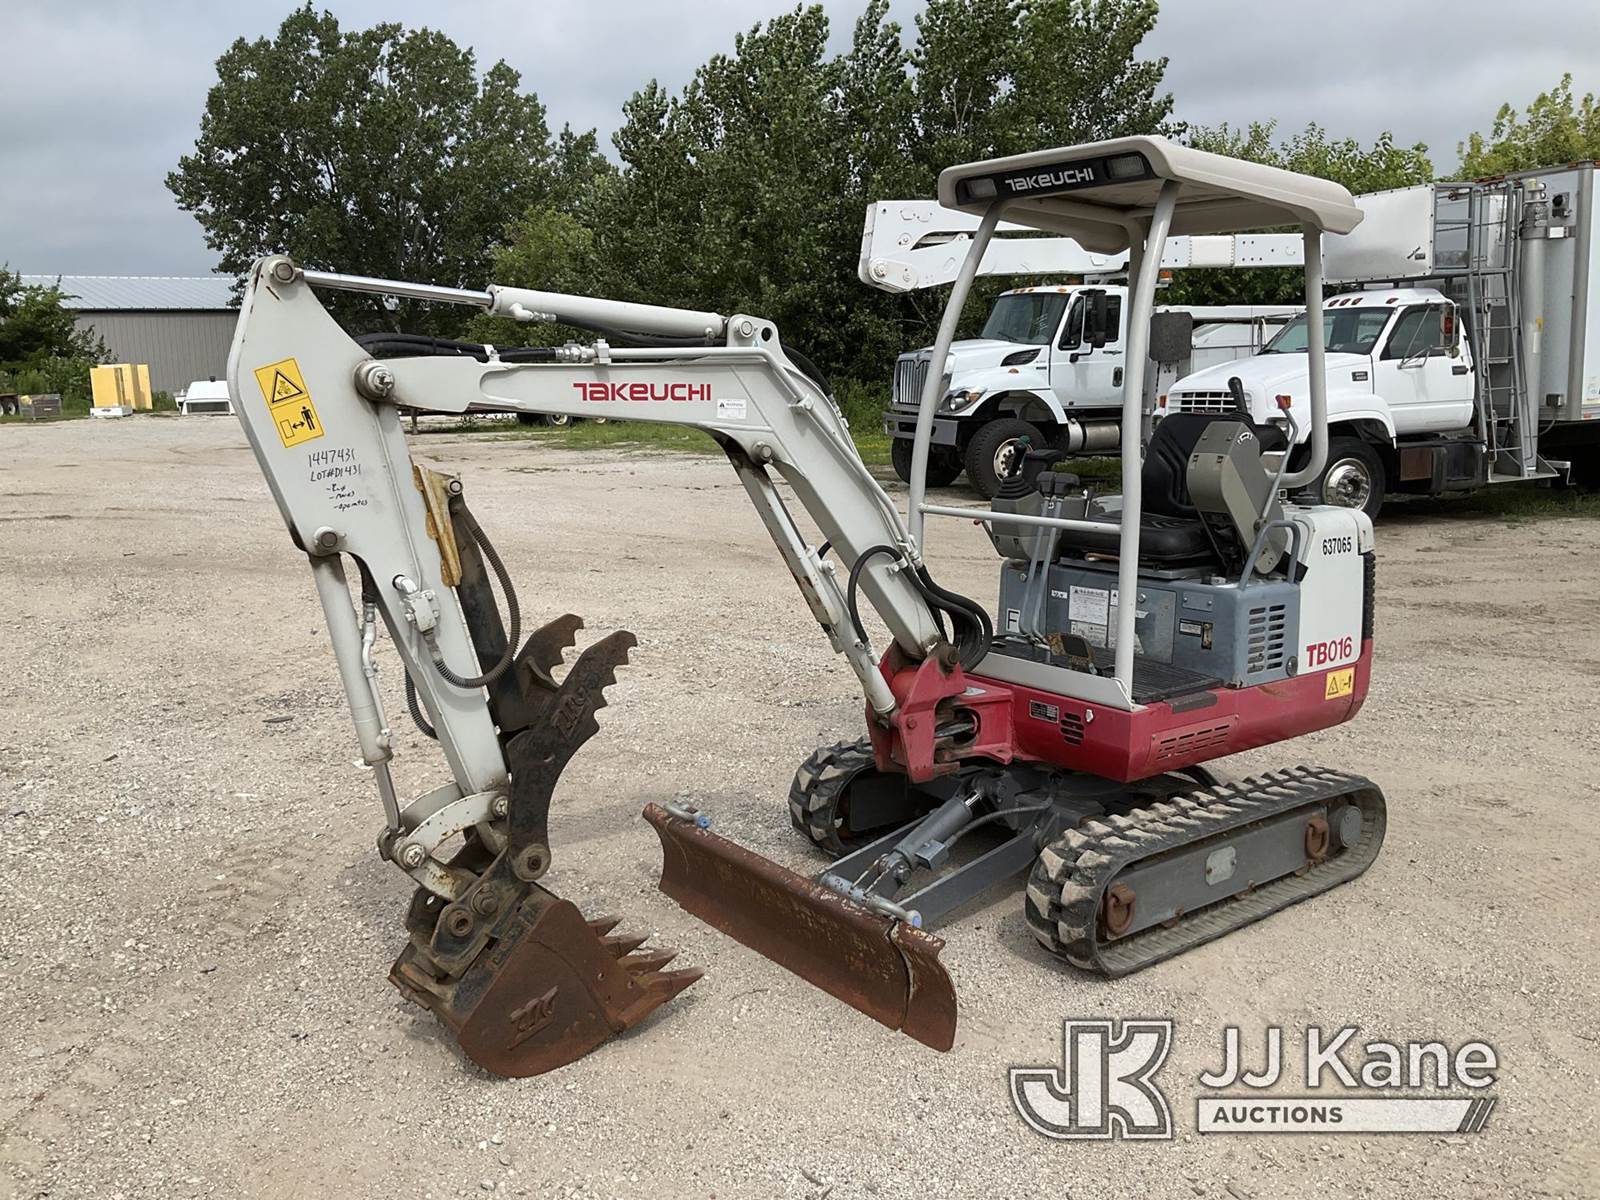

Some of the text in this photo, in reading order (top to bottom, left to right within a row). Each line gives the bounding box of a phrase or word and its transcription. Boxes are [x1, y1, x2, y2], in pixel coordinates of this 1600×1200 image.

[308, 448, 355, 468] 1447431
[1322, 536, 1352, 556] 637065
[1007, 610, 1019, 630] F
[1306, 636, 1353, 668] TB016
